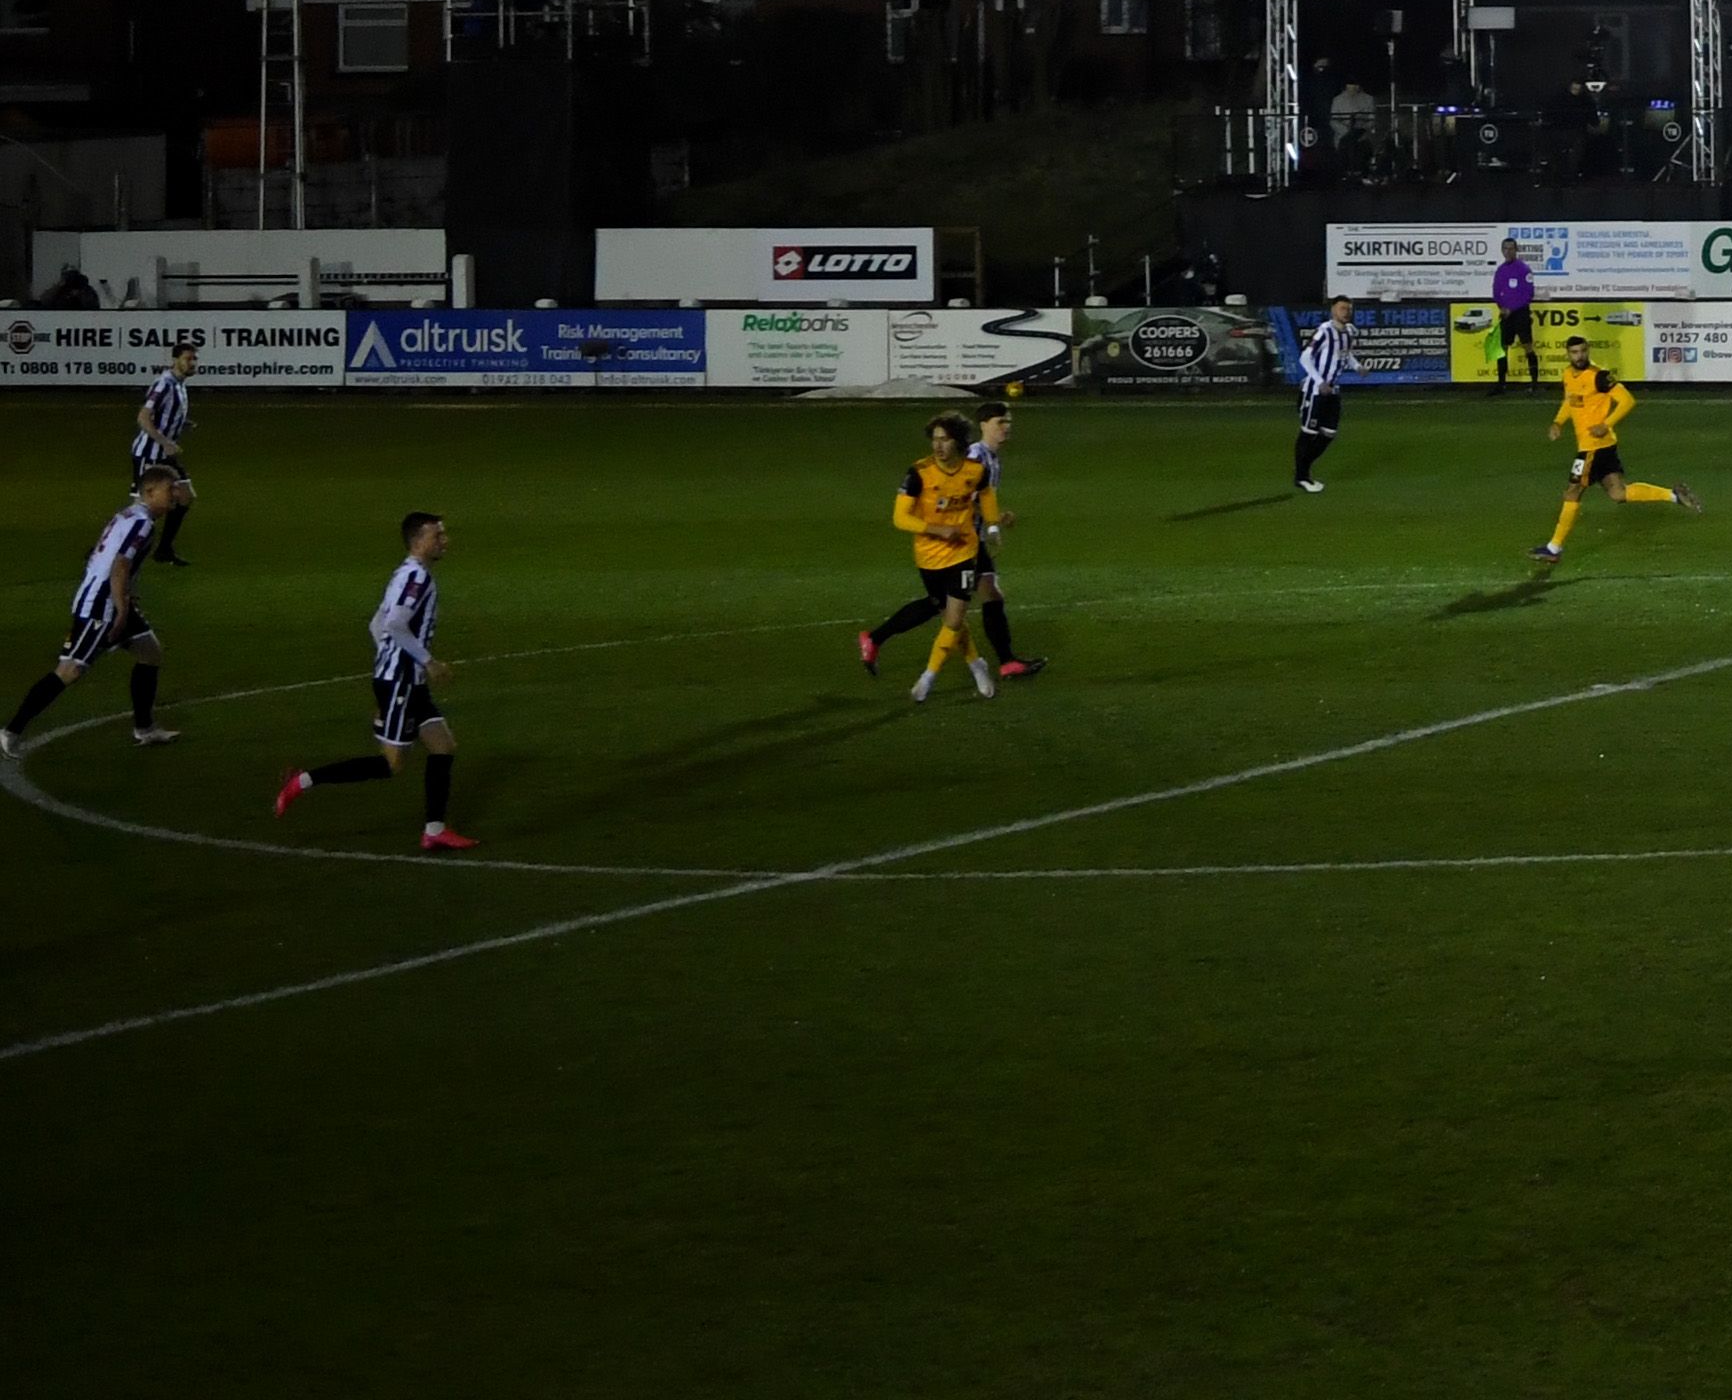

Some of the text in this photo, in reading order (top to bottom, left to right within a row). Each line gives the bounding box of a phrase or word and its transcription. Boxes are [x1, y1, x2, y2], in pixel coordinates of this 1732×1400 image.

[1343, 240, 1488, 257] SKIRTING BOARD
[808, 253, 914, 273] LOTTO
[1353, 310, 1377, 325] BE
[56, 328, 340, 348] HIRE SALES TRAINING
[400, 318, 528, 354] altruisk
[557, 323, 684, 343] Risk Management
[1138, 326, 1200, 339] COOPERS
[1659, 332, 1699, 343] 01257
[1703, 332, 1728, 343] 480
[616, 346, 702, 364] Consultancy
[1143, 345, 1193, 358] 261666
[1, 362, 334, 380] T: 0808 178 9800 wwonestophire.com
[1363, 358, 1401, 370] 01772
